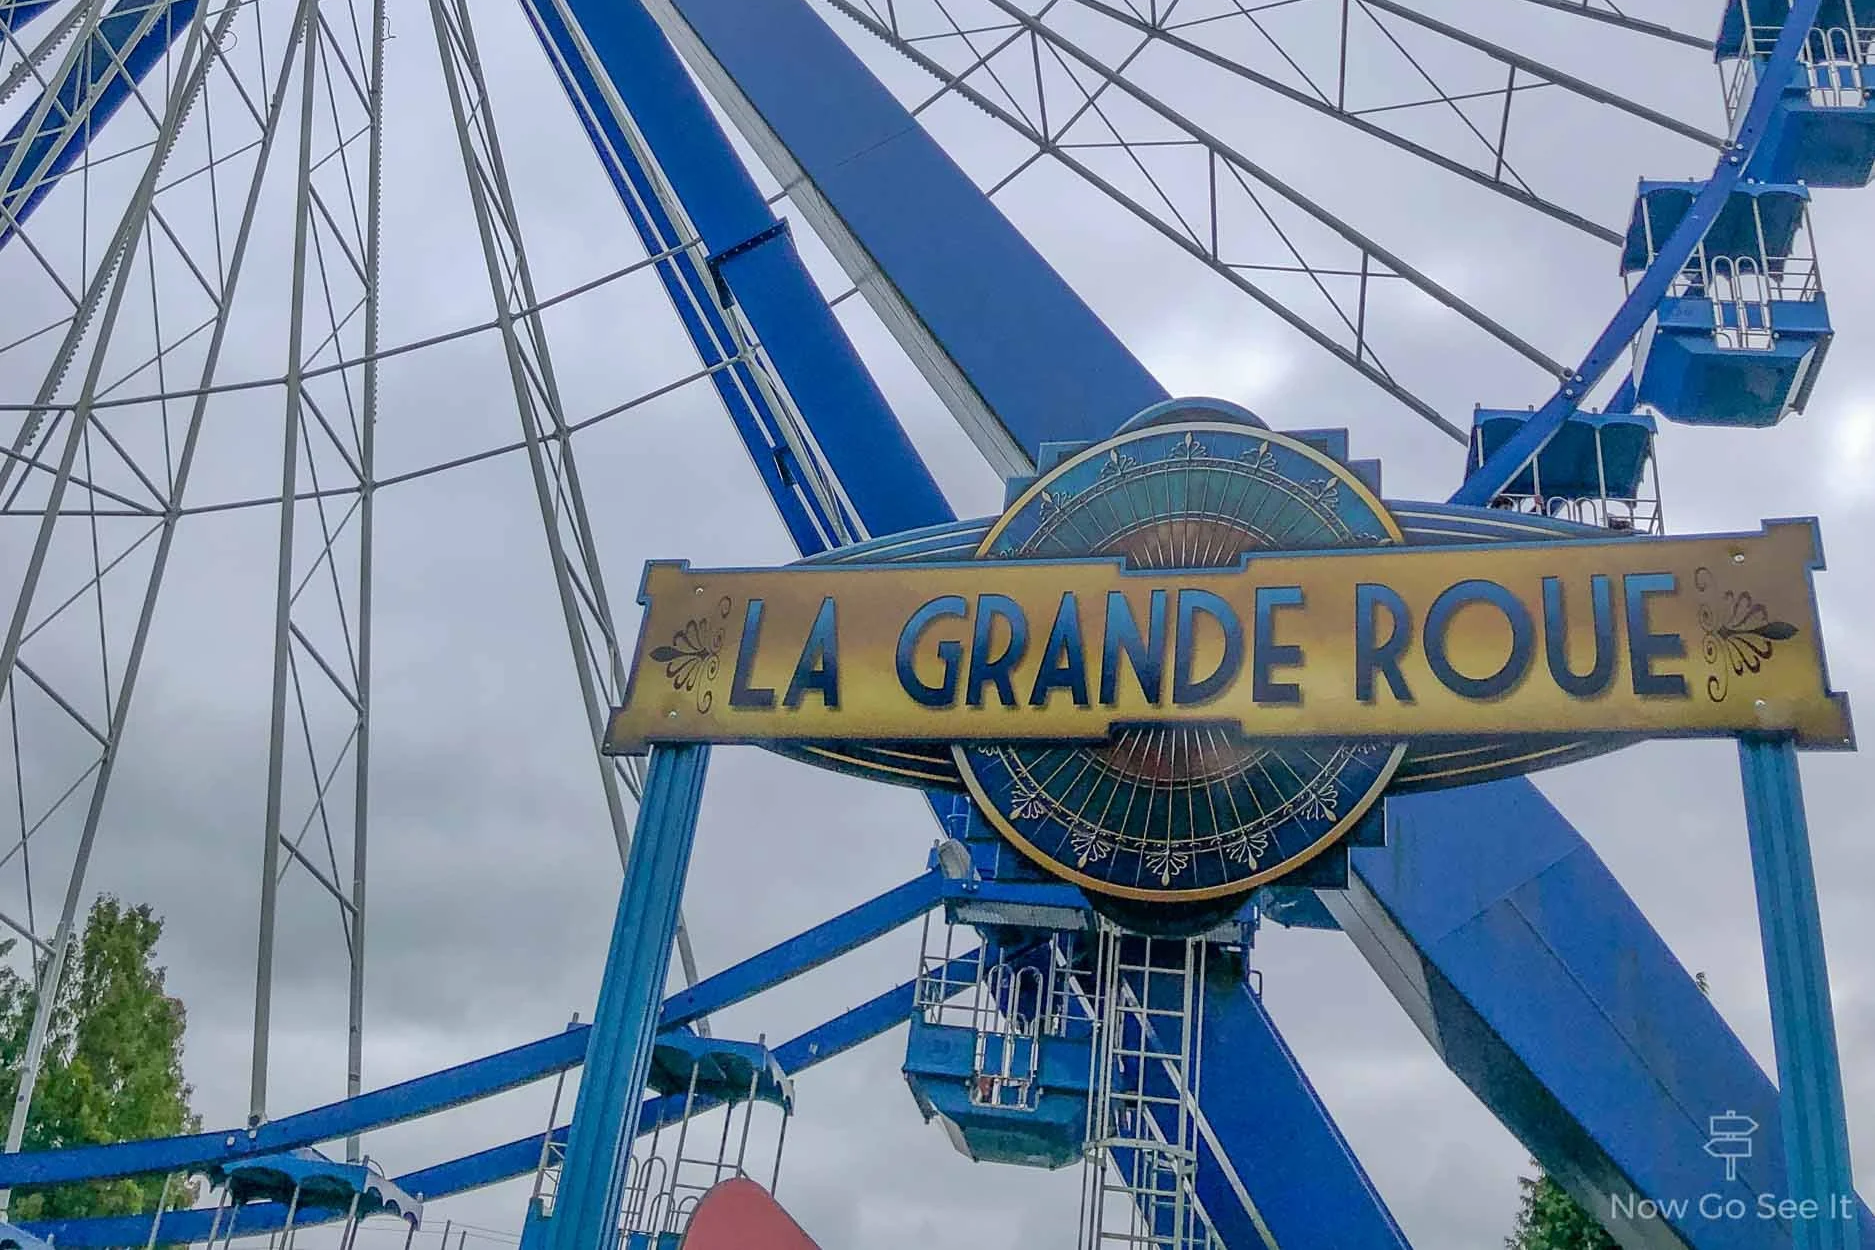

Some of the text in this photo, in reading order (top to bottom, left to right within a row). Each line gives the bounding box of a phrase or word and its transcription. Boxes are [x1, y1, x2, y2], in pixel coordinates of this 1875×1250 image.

[728, 572, 1688, 710] LA GRANDE ROUE
